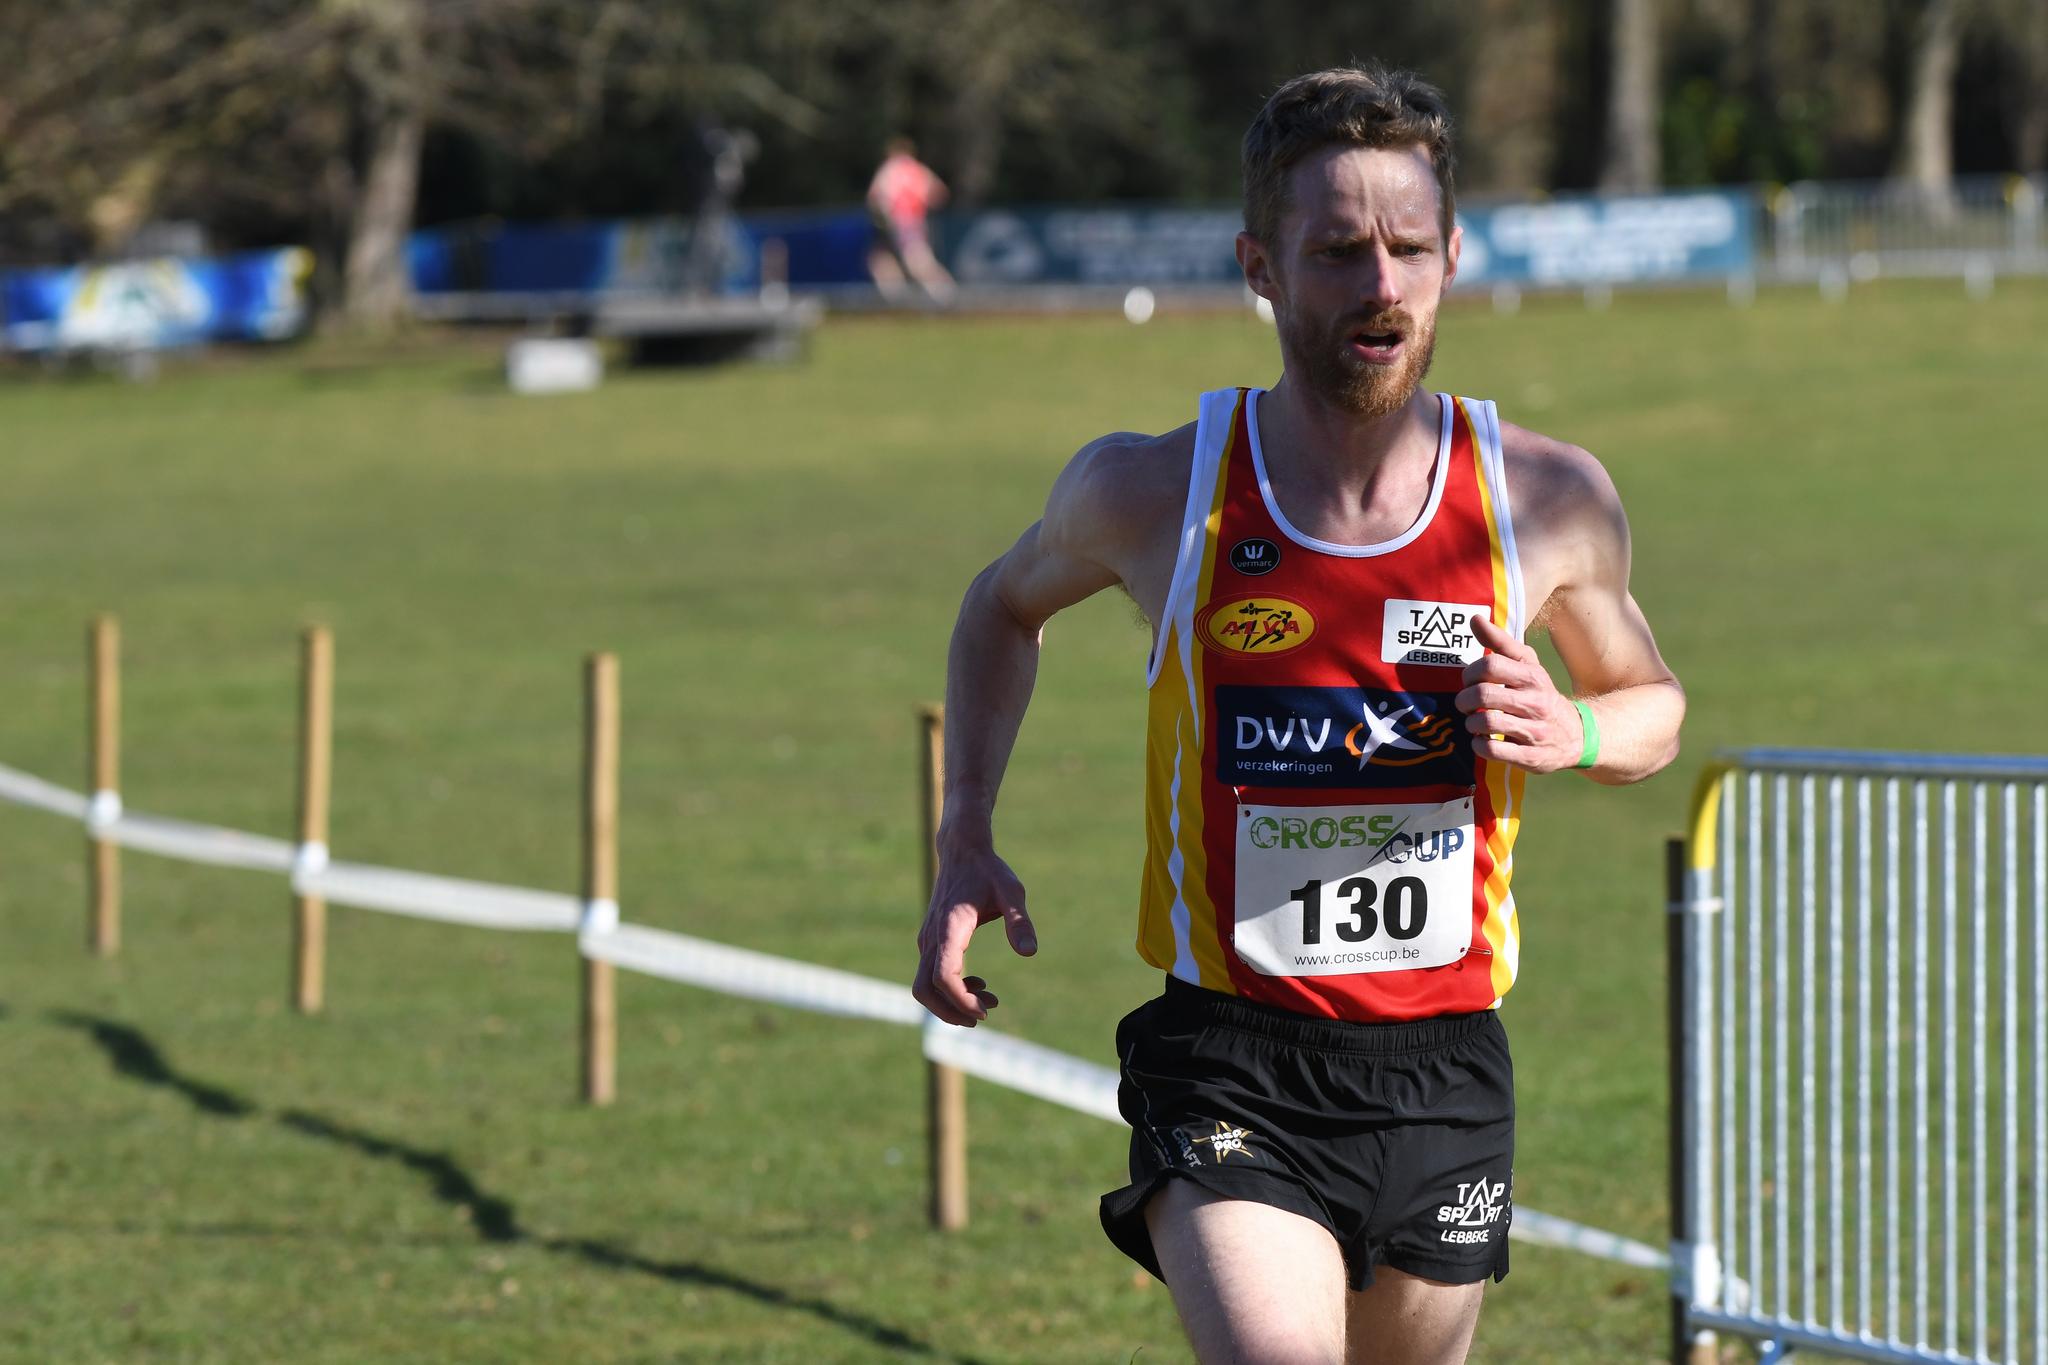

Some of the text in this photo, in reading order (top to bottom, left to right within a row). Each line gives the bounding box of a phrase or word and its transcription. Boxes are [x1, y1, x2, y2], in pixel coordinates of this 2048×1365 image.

[1236, 560, 1273, 568] vermarc
[1219, 619, 1302, 635] ALVA
[1406, 651, 1463, 665] LEBBEKE
[1235, 716, 1332, 752] DVV
[1236, 760, 1333, 775] verzekeringen
[1251, 815, 1465, 864] CROSS CUP
[1290, 876, 1428, 945] 130
[1294, 946, 1420, 966] www.crosscup.be
[1171, 1127, 1202, 1168] CRAFT
[1440, 1229, 1490, 1244] LEBBEKE
